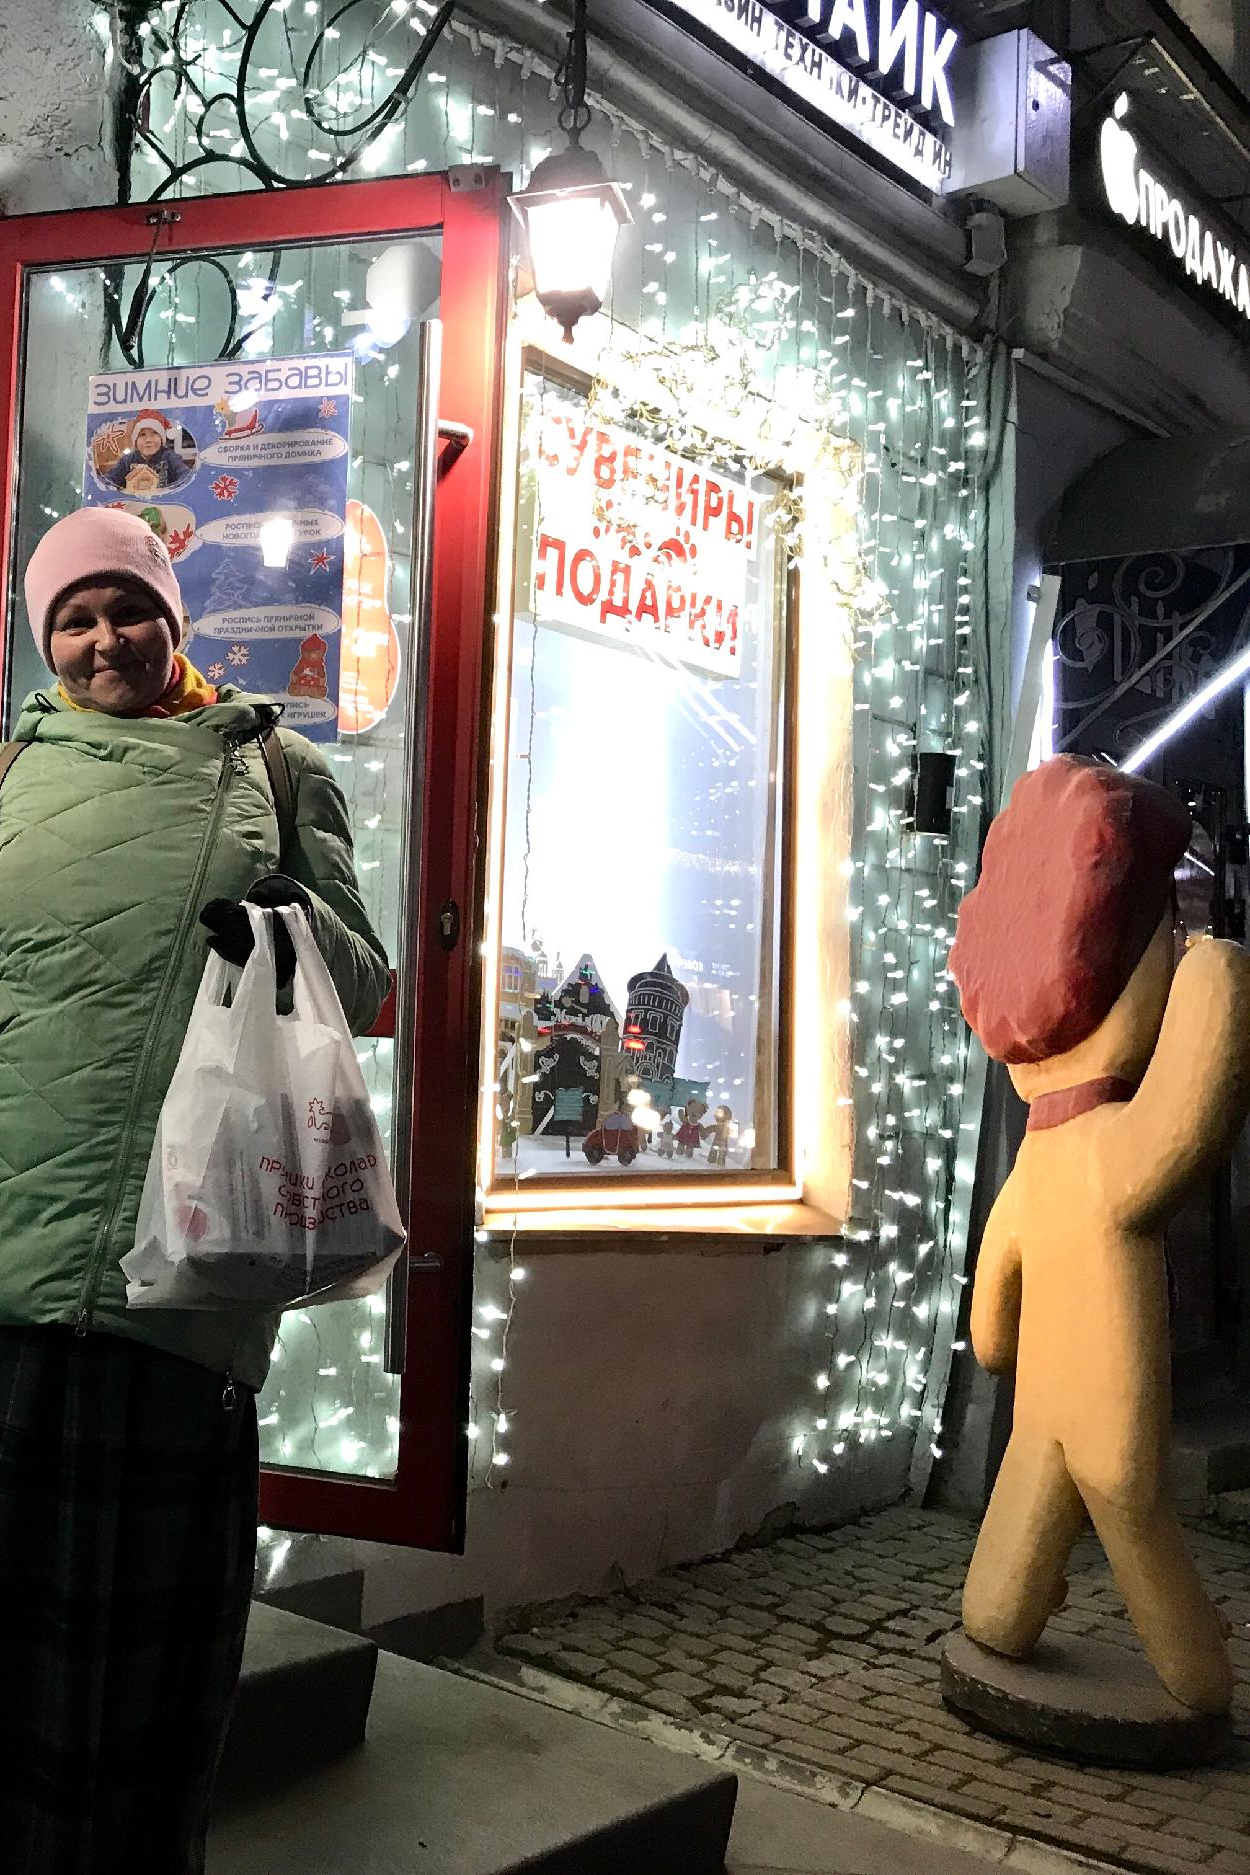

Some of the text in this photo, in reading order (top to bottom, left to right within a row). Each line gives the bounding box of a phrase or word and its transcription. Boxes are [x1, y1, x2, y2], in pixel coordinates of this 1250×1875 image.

[932, 138, 953, 180] ИН
[1138, 167, 1250, 321] ПРОДАЖА
[217, 444, 251, 454] СБОРКА
[284, 449, 322, 460] ДОМИКА
[536, 533, 739, 656] ПОДАРКИ
[287, 711, 327, 719] ИГРУШЕК
